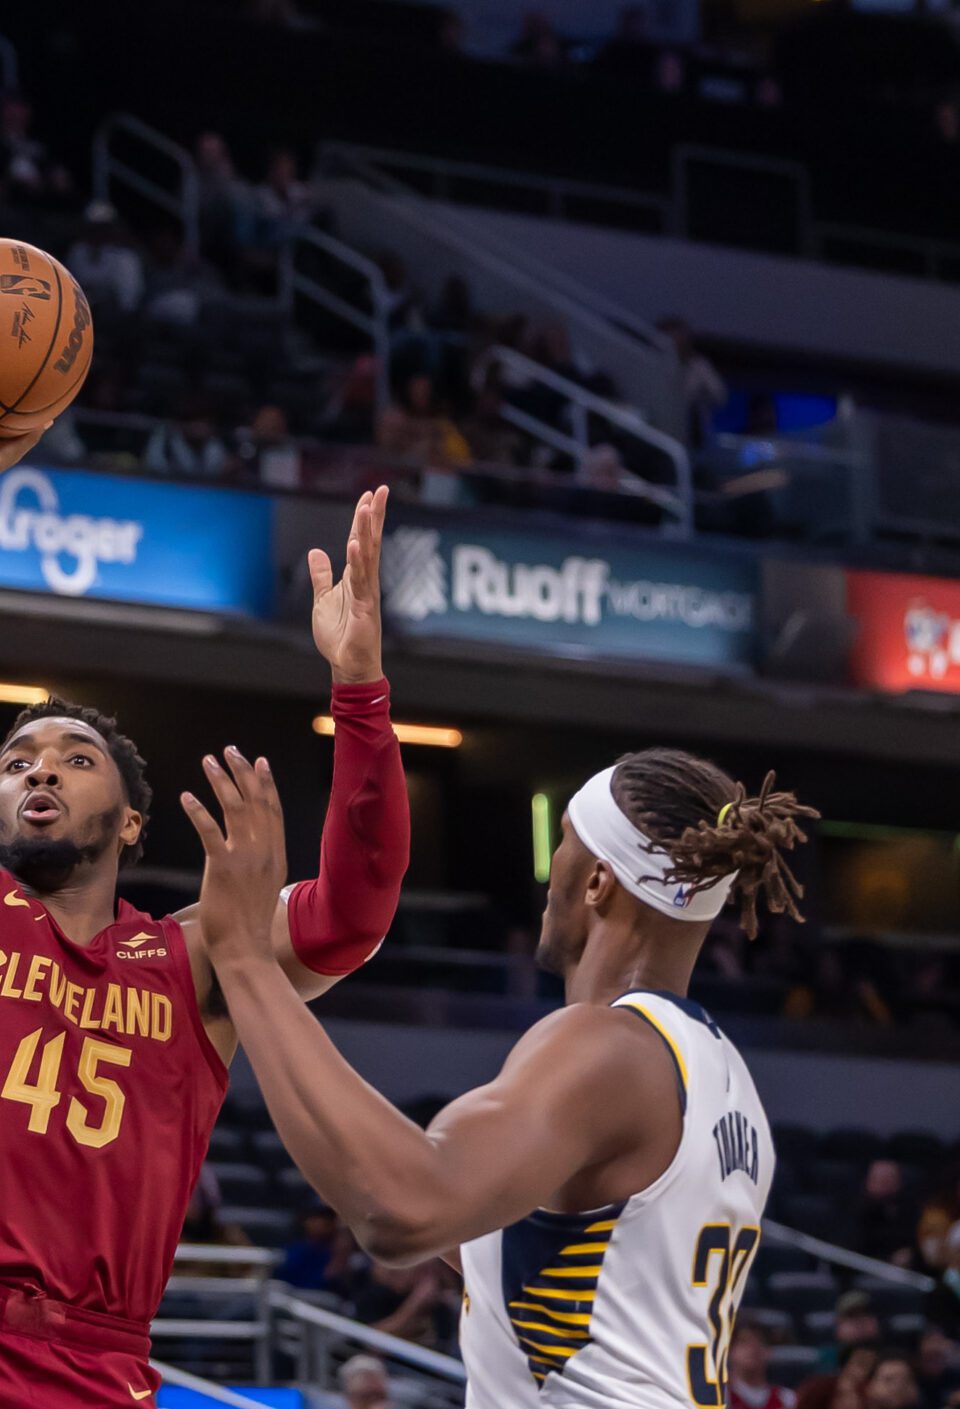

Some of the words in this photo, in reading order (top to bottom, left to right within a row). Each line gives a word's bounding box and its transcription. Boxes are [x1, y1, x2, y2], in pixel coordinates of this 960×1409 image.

[451, 544, 611, 627] Ruoff
[116, 947, 168, 961] CLIFFS
[0, 1026, 133, 1150] 45
